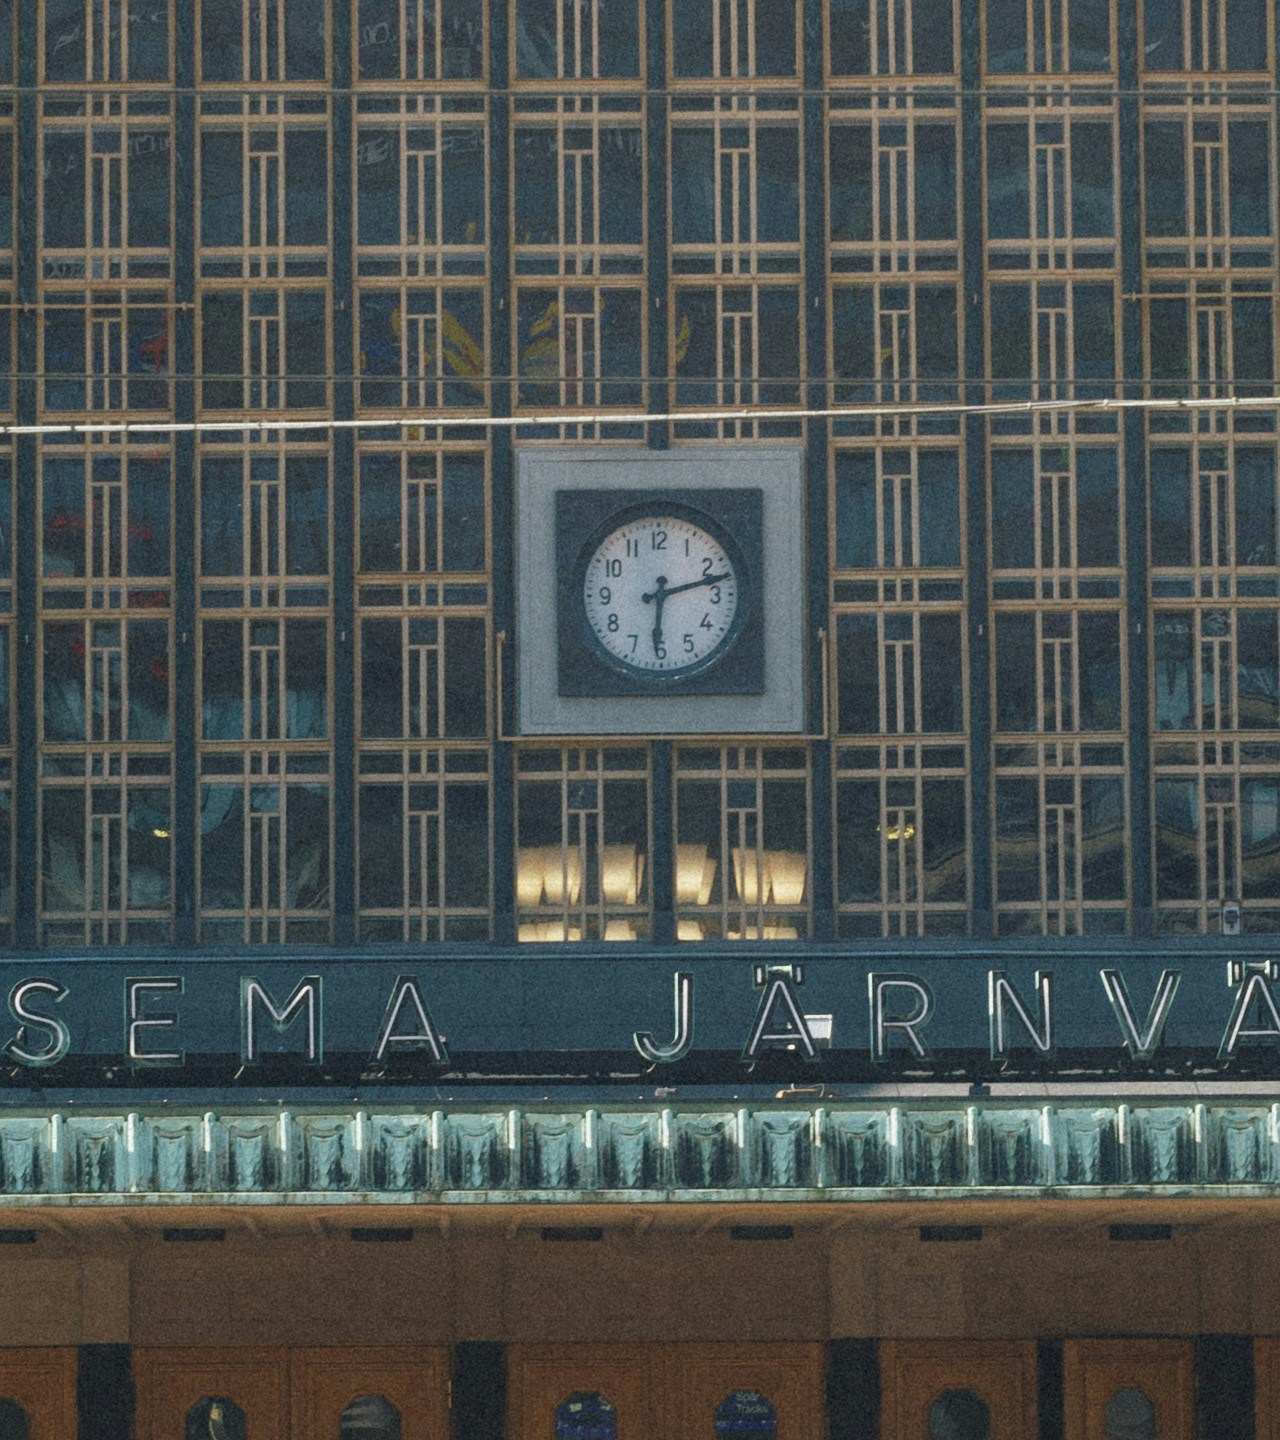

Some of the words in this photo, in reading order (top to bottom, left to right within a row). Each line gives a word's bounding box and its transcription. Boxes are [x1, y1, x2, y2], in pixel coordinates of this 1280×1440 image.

[626, 538, 638, 557] 11
[651, 531, 668, 550] 12
[684, 538, 690, 557] 1
[605, 558, 622, 577] 10
[701, 557, 714, 577] 2
[599, 586, 612, 606] 9
[710, 586, 721, 605] 3
[607, 613, 619, 633] 8
[699, 613, 714, 632] 4
[627, 634, 638, 654] 7
[654, 640, 667, 660] 6
[683, 633, 695, 653] 5
